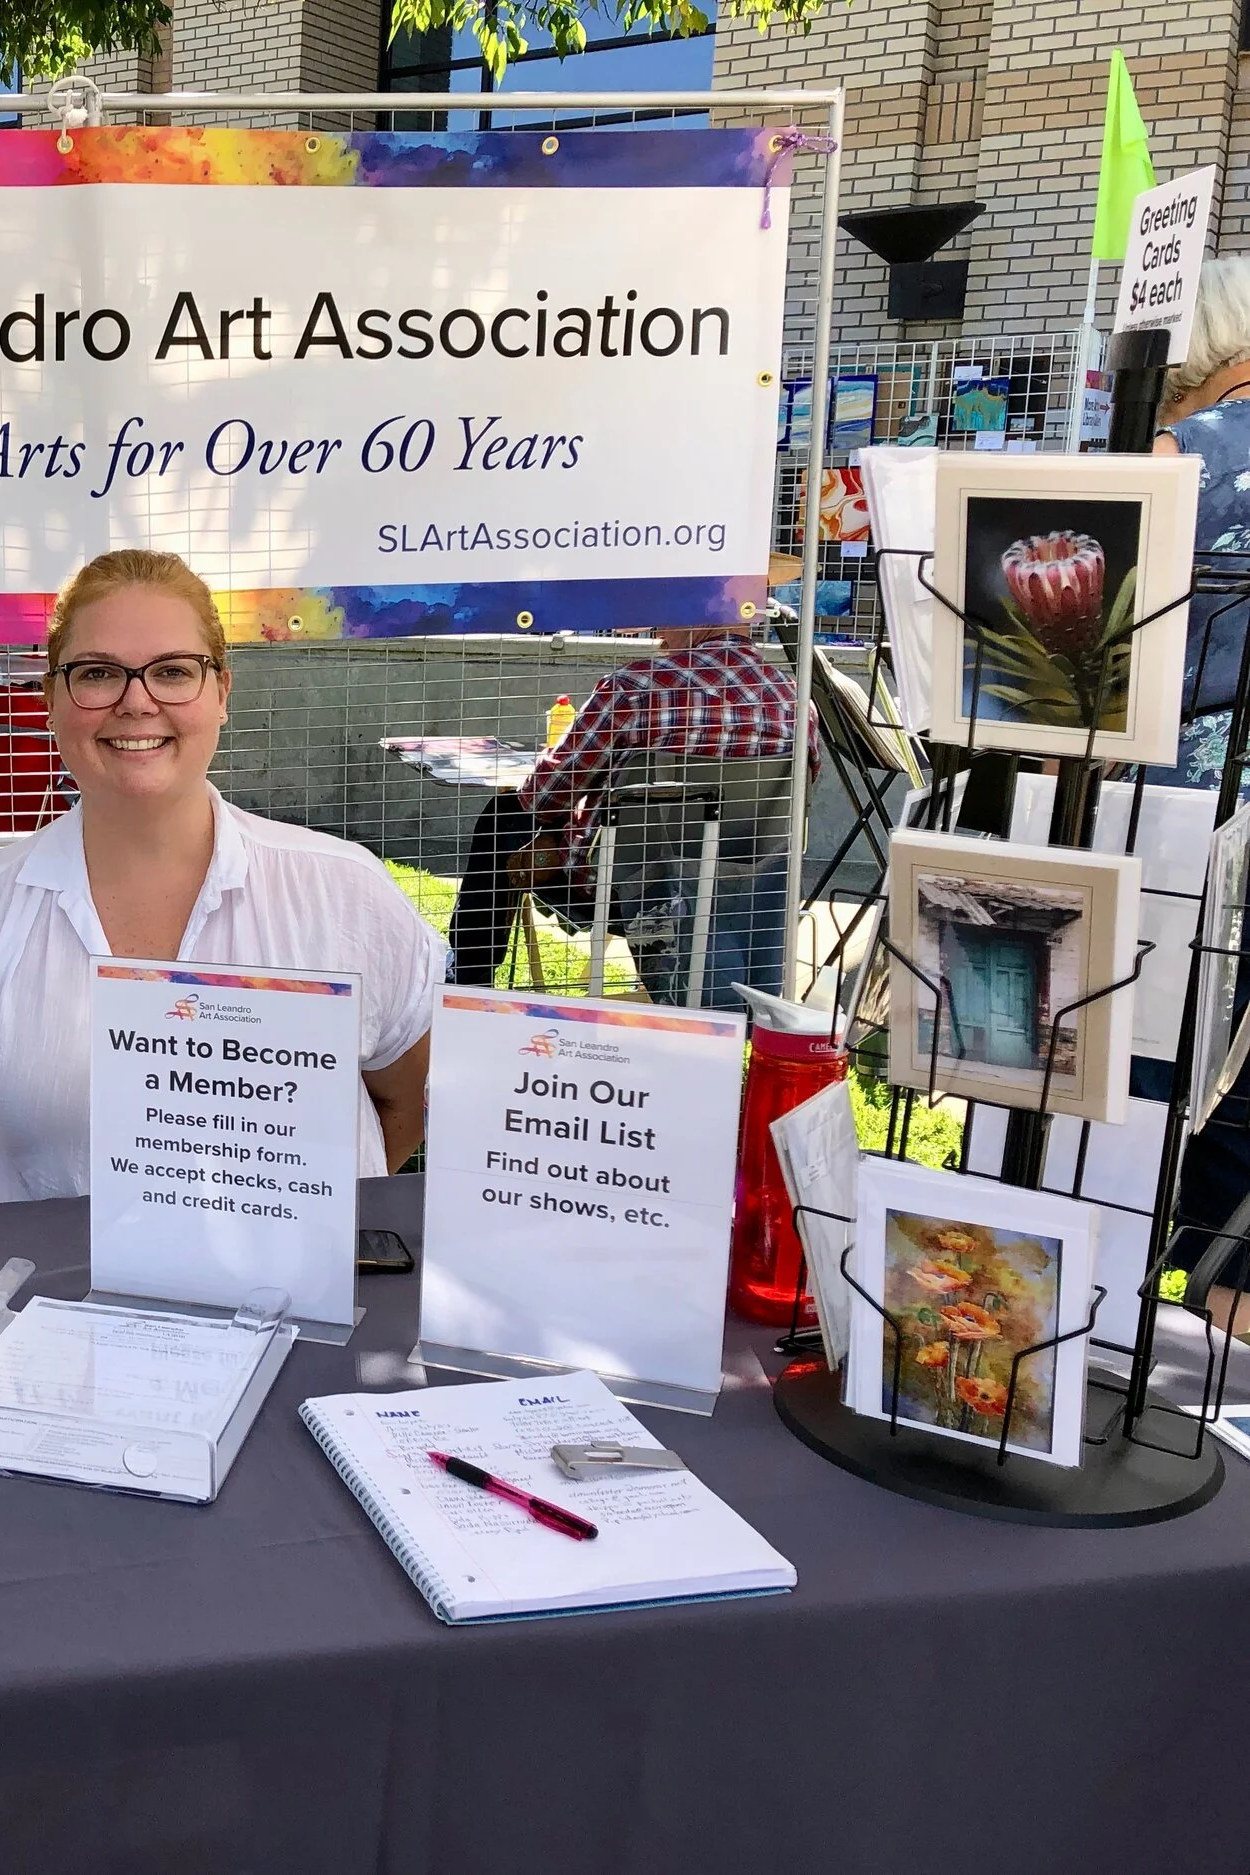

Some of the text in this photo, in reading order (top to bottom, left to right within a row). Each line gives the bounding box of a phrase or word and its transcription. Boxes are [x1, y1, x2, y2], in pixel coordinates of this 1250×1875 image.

[1140, 192, 1198, 236] Greeting
[1142, 234, 1181, 272] Cards
[1130, 271, 1183, 314] $4 each
[155, 291, 272, 361] Art
[293, 289, 728, 361] Association
[91, 416, 183, 499] for
[205, 417, 342, 476] Over
[361, 414, 435, 473] 60
[453, 415, 584, 471] Years
[377, 519, 726, 555] SLArtAssociation.org
[199, 1002, 251, 1014] San Leandro
[199, 1012, 262, 1024] Art Association
[109, 1028, 337, 1070] Want to Become
[558, 1049, 630, 1064] Art Association
[559, 1039, 619, 1053] San Leandro
[145, 1070, 298, 1103] a Member?
[514, 1072, 650, 1108] Join Our
[146, 1108, 296, 1137] Please fill in our
[505, 1109, 656, 1150] Email List
[135, 1136, 307, 1166] membership form.
[111, 1157, 333, 1197] We accept checks, cash
[487, 1150, 670, 1193] Find out about
[143, 1190, 298, 1220] and credit cards.
[482, 1188, 669, 1228] our shows, etc.
[376, 1410, 422, 1418] NAME
[518, 1396, 570, 1407] EMAIL
